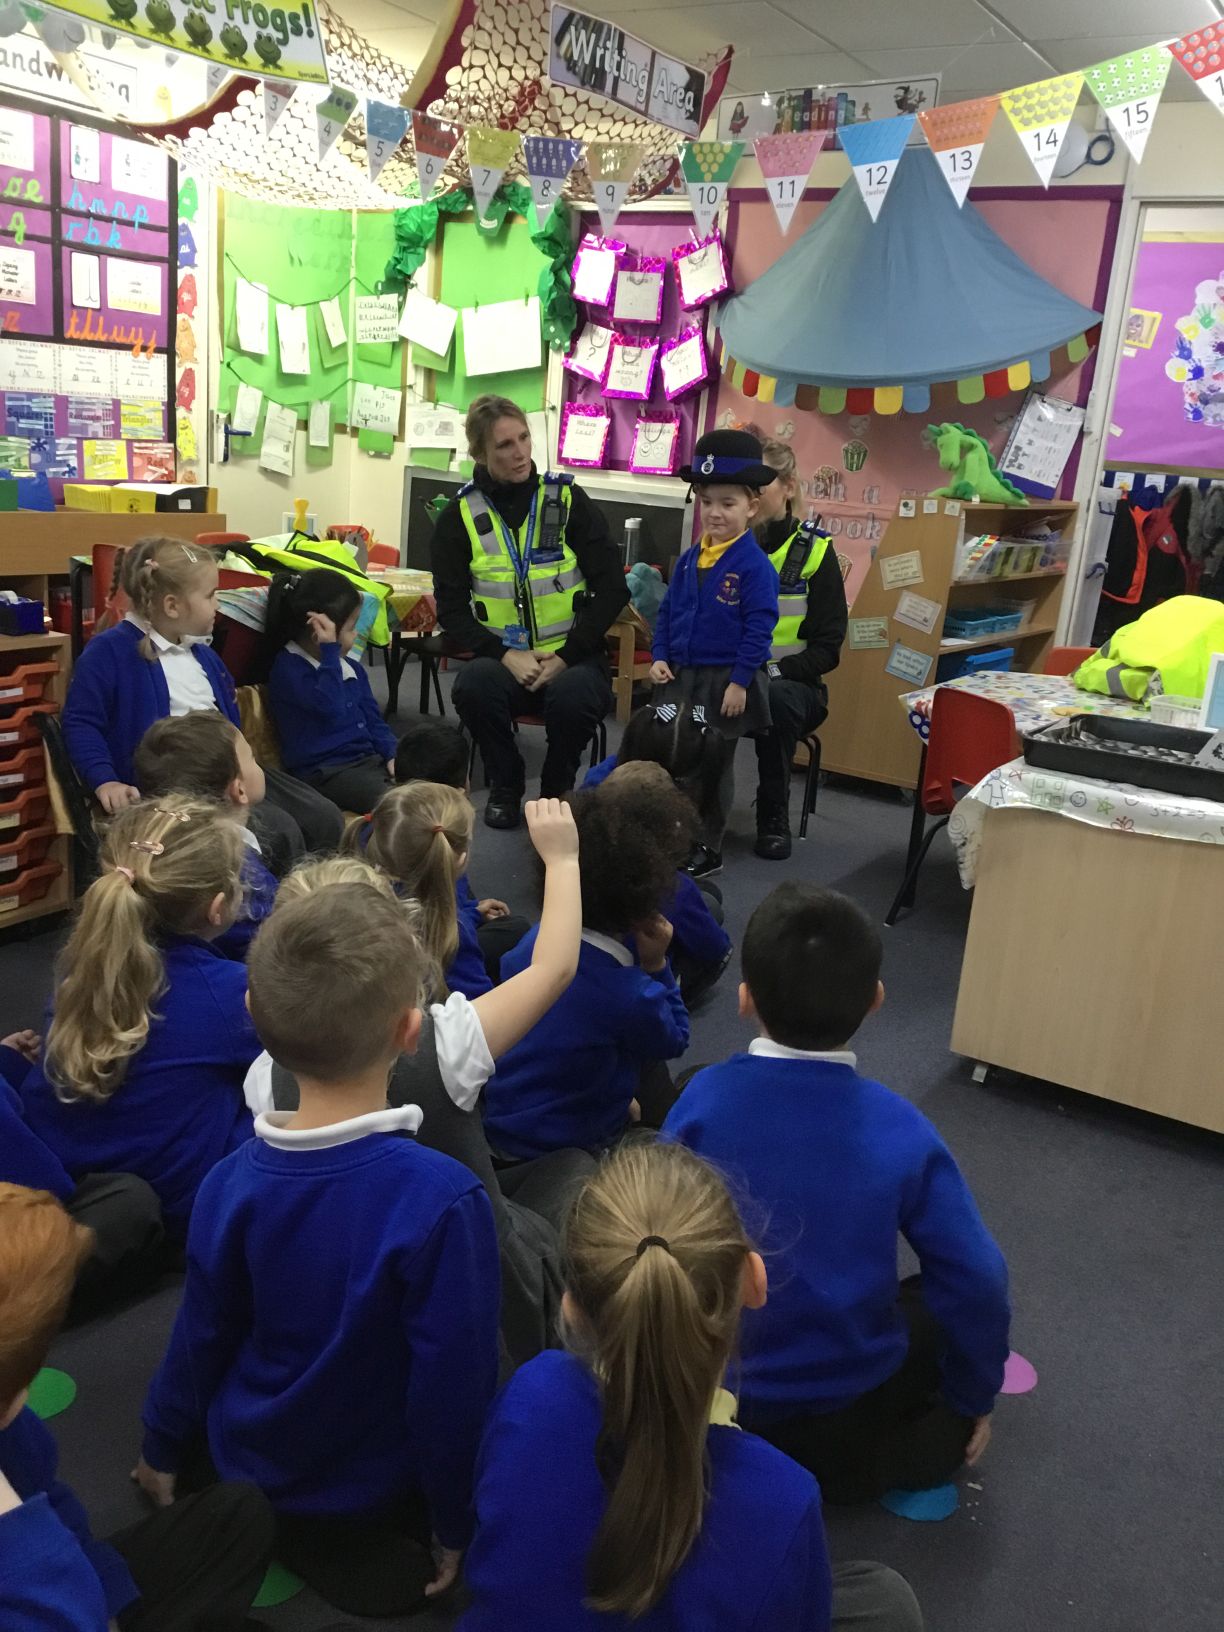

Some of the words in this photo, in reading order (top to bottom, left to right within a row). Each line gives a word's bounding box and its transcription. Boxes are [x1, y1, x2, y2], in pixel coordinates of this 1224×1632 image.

[226, 0, 315, 46] Frogs!
[570, 25, 650, 104] Writing
[653, 68, 696, 114] Area
[269, 95, 278, 111] 3
[1122, 102, 1149, 128] 15
[323, 121, 332, 137] 4
[1124, 126, 1152, 142] fifteen
[374, 141, 384, 157] 5
[1033, 128, 1058, 152] 14
[425, 158, 434, 175] 6
[949, 150, 973, 173] 13
[481, 169, 491, 187] 7
[865, 166, 888, 186] 12
[541, 179, 551, 198] 8
[605, 185, 616, 202] 9
[698, 186, 718, 204] 10
[777, 181, 796, 199] 11
[147, 456, 164, 467] Red
